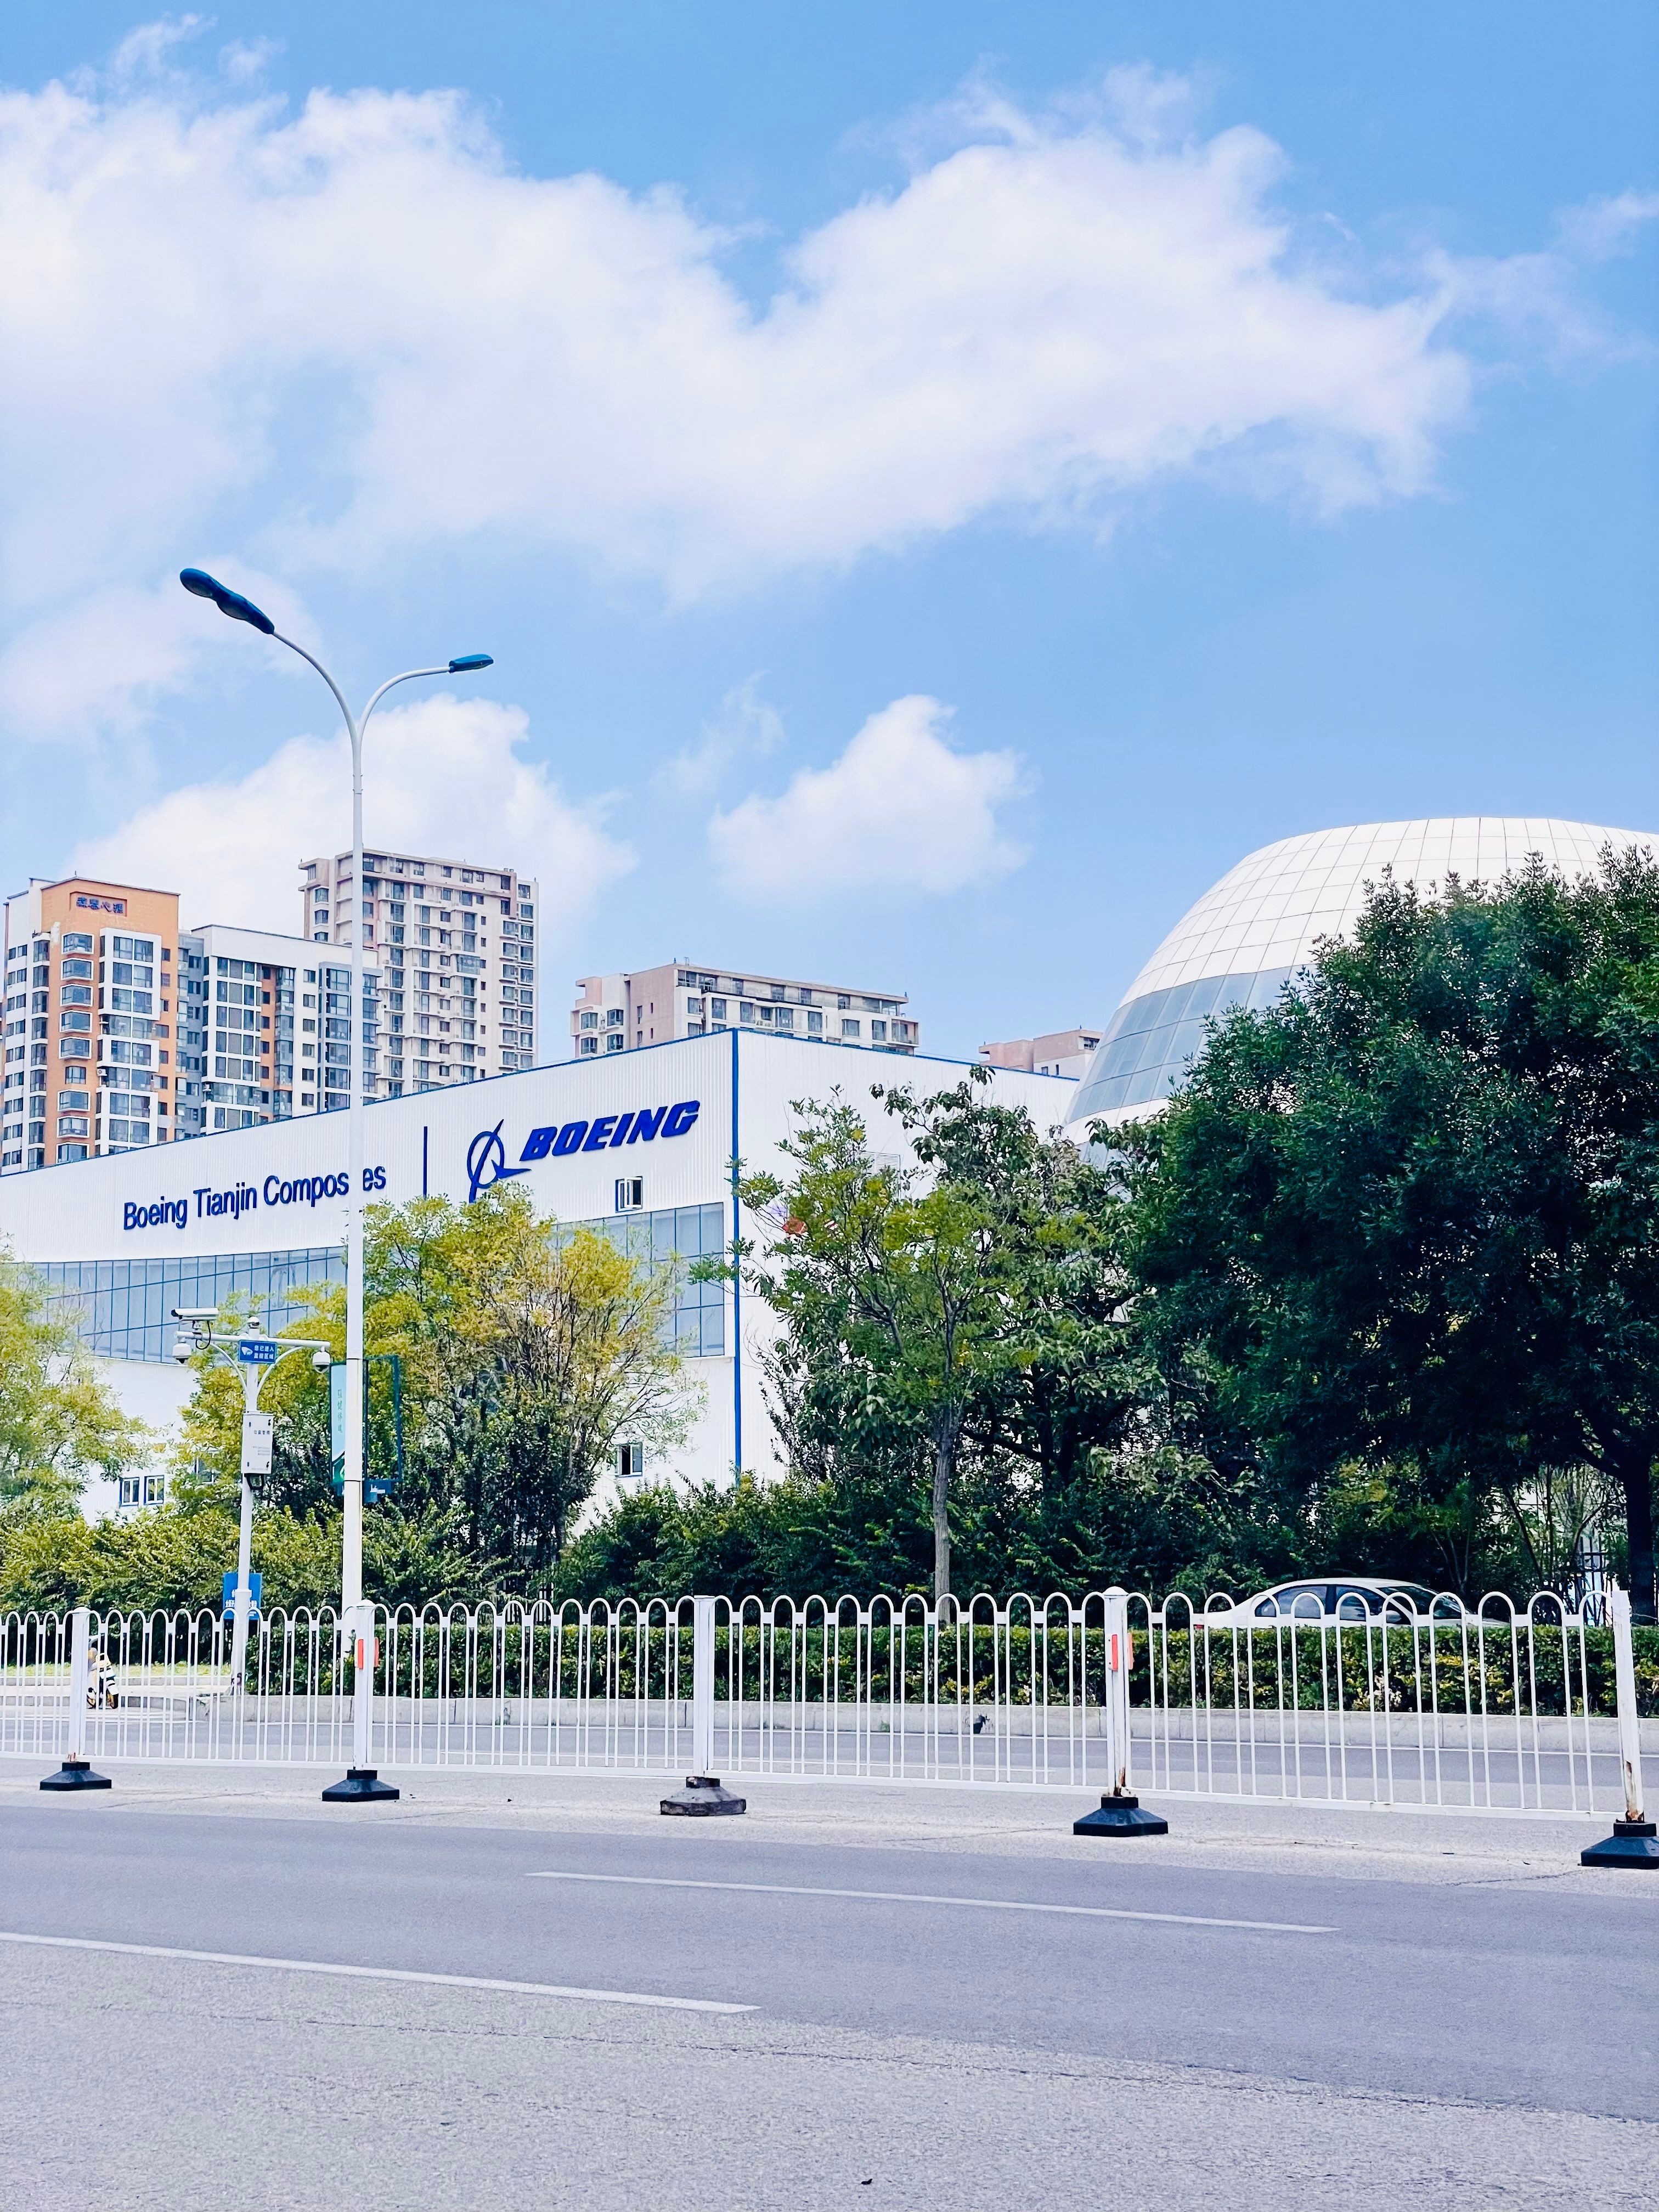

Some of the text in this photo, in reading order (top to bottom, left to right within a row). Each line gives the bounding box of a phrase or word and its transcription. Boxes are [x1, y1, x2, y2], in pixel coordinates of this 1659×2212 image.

[520, 1101, 700, 1161] BOEING
[124, 1166, 386, 1230] Boeing Tianjin Composes
